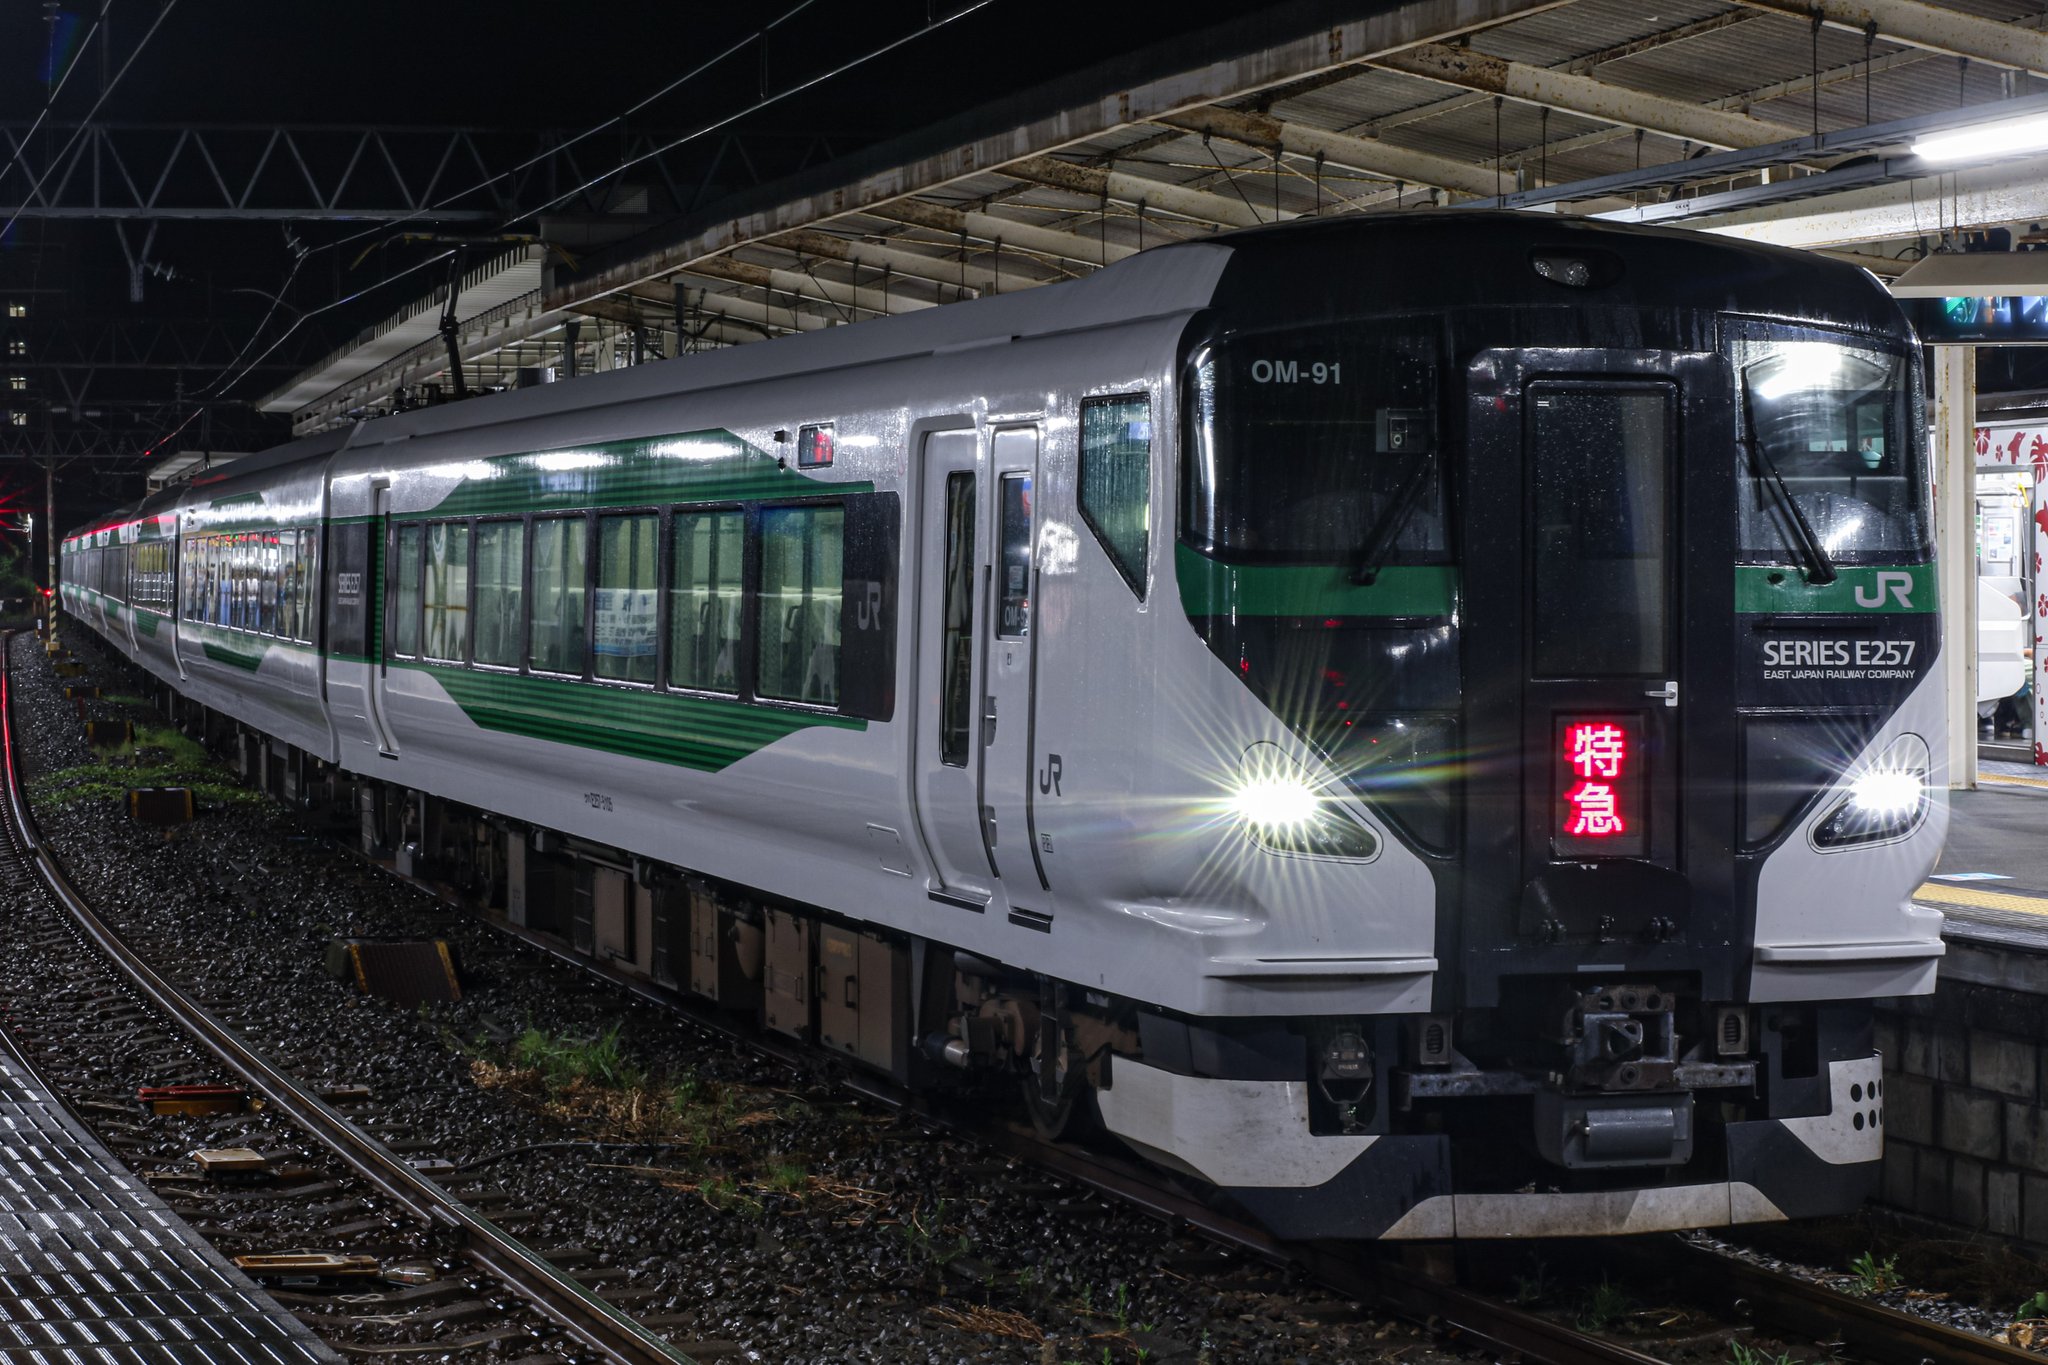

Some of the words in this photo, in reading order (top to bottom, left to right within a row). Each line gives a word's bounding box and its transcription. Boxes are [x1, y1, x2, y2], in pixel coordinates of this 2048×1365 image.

[1251, 359, 1341, 385] OM-91
[857, 581, 881, 631] JR
[1854, 571, 1914, 609] JR
[1004, 605, 1028, 627] OM-9
[1763, 640, 1850, 667] SERIES
[1855, 640, 1916, 667] E257
[1763, 669, 1790, 680] EAST
[1791, 669, 1824, 680] JAPAN
[1826, 669, 1867, 680] RAILWAY
[1867, 669, 1916, 680] COMPANY
[1040, 753, 1062, 797] JR
[1572, 724, 1622, 833] 特急
